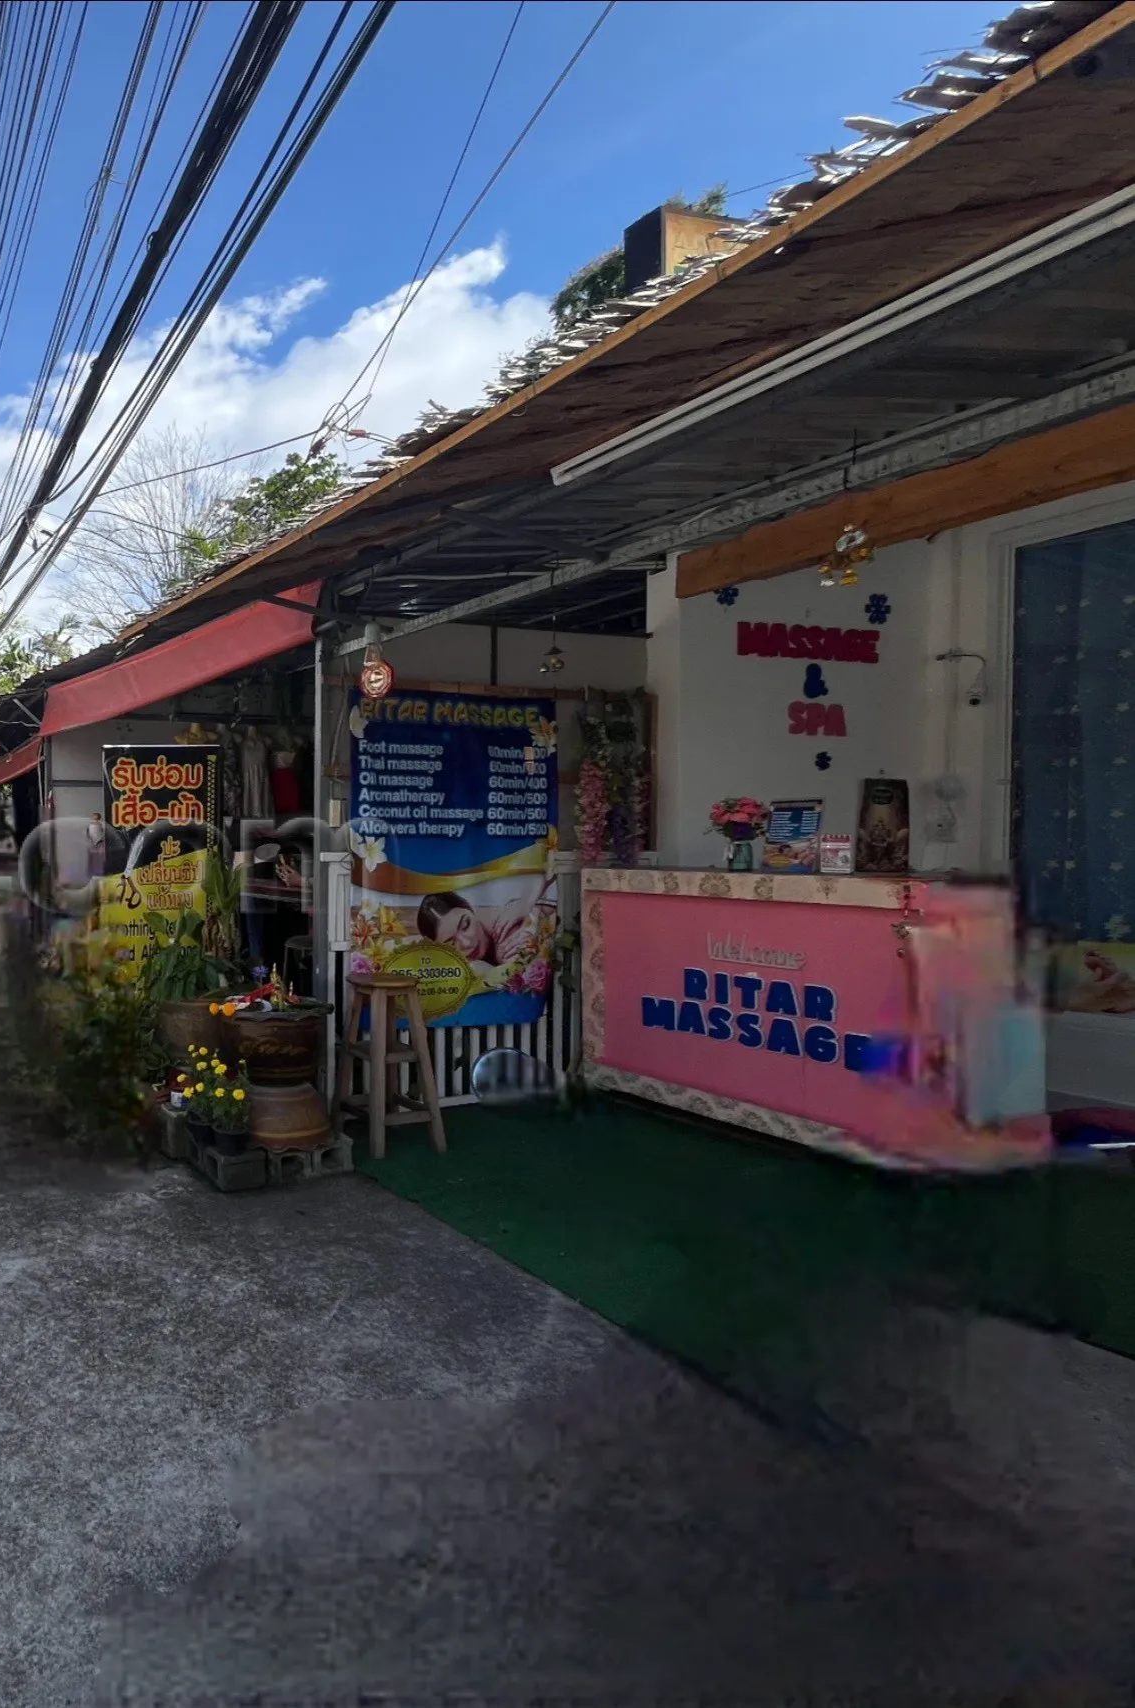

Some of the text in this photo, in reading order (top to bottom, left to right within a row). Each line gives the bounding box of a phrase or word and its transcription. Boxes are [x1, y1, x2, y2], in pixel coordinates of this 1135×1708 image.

[737, 622, 880, 663] MASSAGE
[803, 663, 829, 698] &
[433, 700, 541, 729] MASSAGE
[787, 701, 846, 736] SPA
[358, 740, 385, 754] Foot
[388, 743, 444, 758] massage
[358, 755, 385, 769] Thai
[387, 758, 443, 774] massage
[111, 755, 204, 790] รับซ่อม
[358, 771, 377, 785] Oil
[379, 774, 434, 789] massage
[111, 788, 204, 827] เสื้อ-ผ้า
[358, 788, 548, 805] Aromatherapy 60min/500
[358, 804, 548, 822] Coconut oil massage 60min/500
[358, 820, 388, 835] Aloe
[390, 822, 416, 835] vera
[418, 820, 465, 837] therapy
[706, 930, 806, 968] Welcome
[683, 967, 837, 1023] RITAR
